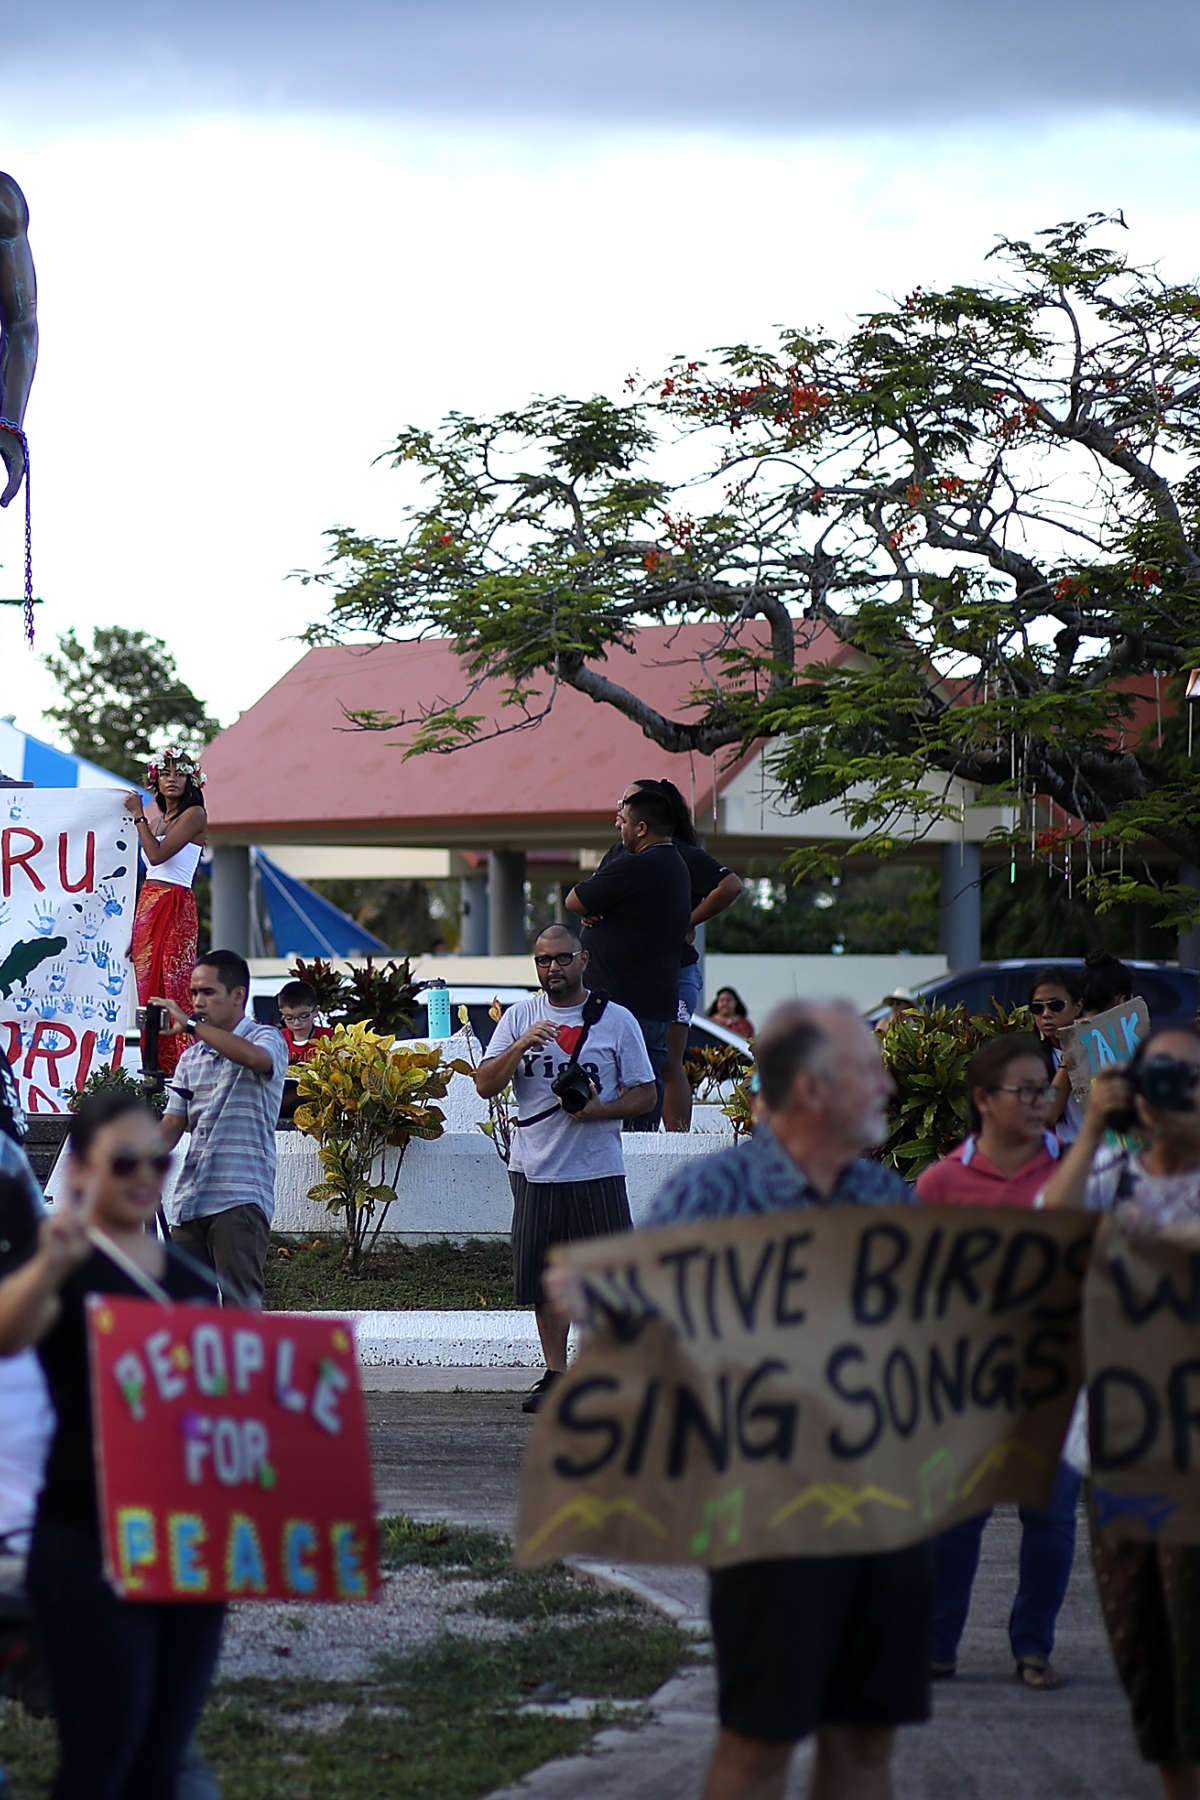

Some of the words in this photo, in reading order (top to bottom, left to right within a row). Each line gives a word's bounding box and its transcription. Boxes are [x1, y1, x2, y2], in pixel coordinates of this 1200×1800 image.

[1080, 1011, 1141, 1074] TALK
[113, 1324, 349, 1435] PEOPLE
[552, 1360, 801, 1480] SING
[825, 1329, 1070, 1460] SONGS
[184, 1417, 274, 1487] FOR
[117, 1506, 368, 1598] PEACE
